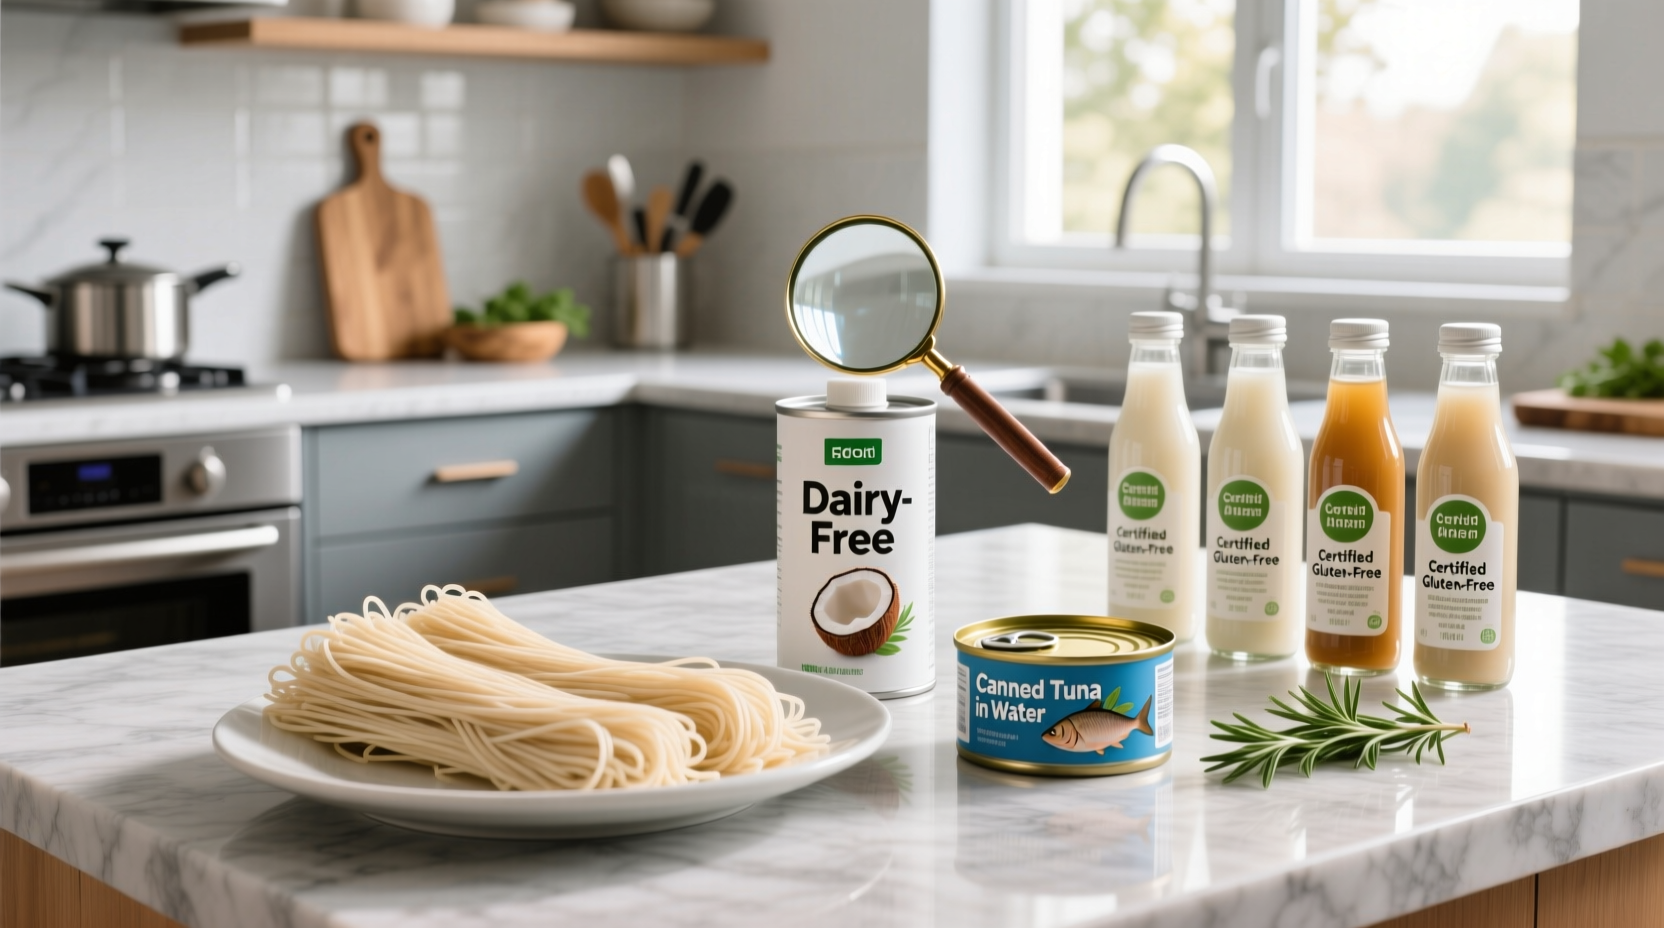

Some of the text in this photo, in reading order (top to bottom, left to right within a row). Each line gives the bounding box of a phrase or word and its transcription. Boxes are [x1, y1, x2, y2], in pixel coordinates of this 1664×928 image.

[803, 480, 912, 525] Dairy-
[811, 520, 895, 555] Free
[1217, 536, 1270, 551] Certified
[1318, 549, 1374, 564] Certified
[1428, 560, 1486, 576] Certified
[1422, 575, 1495, 592] Gluten-Free
[976, 672, 1102, 700] Canned Tuna
[975, 696, 1046, 723] in Water
